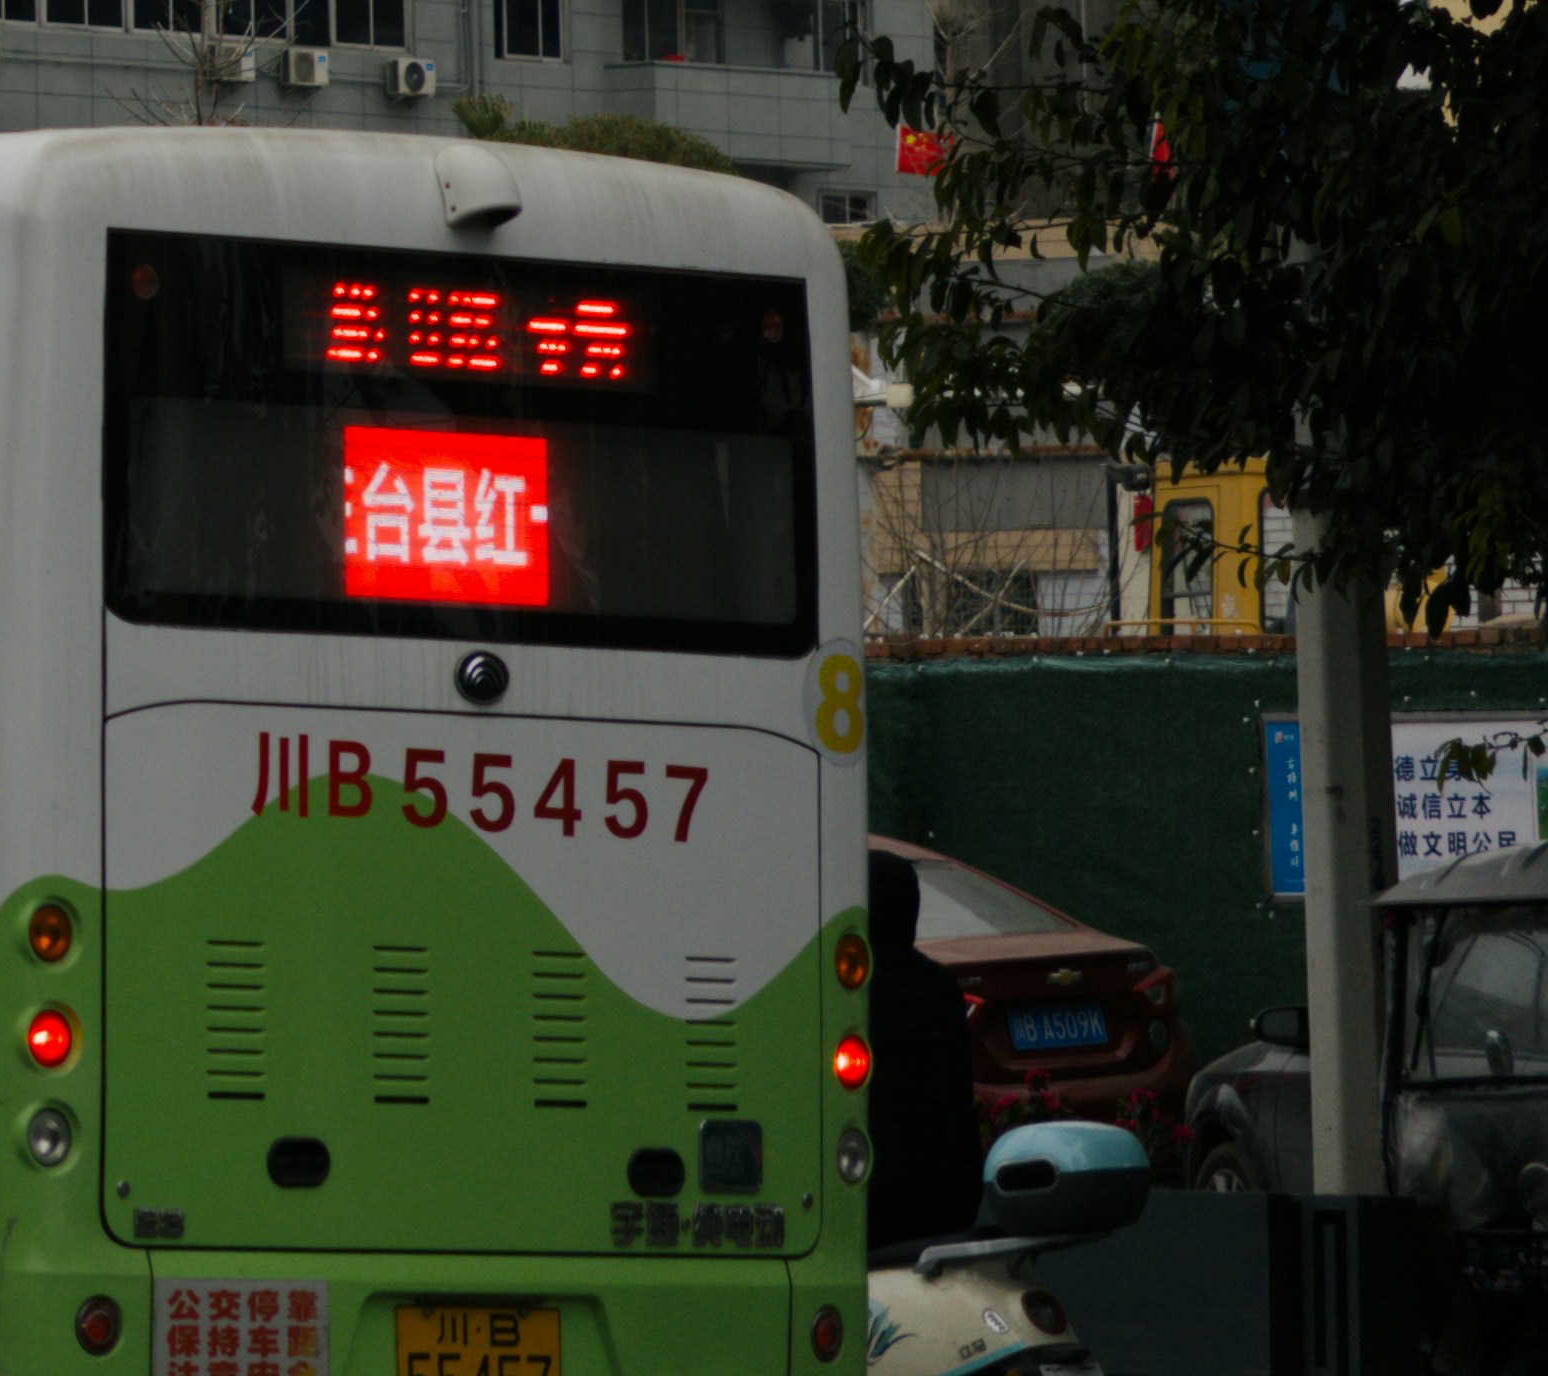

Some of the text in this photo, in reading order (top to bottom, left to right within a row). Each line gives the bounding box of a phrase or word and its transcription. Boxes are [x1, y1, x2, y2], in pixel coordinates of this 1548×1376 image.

[345, 461, 548, 566] 台县红
[818, 654, 864, 755] 8
[252, 730, 711, 843] 川B55457
[1397, 792, 1492, 820] 诚信立本
[1398, 830, 1517, 858] 做文明公民
[168, 1290, 318, 1322] 公交停靠
[167, 1325, 319, 1358] 保持车距
